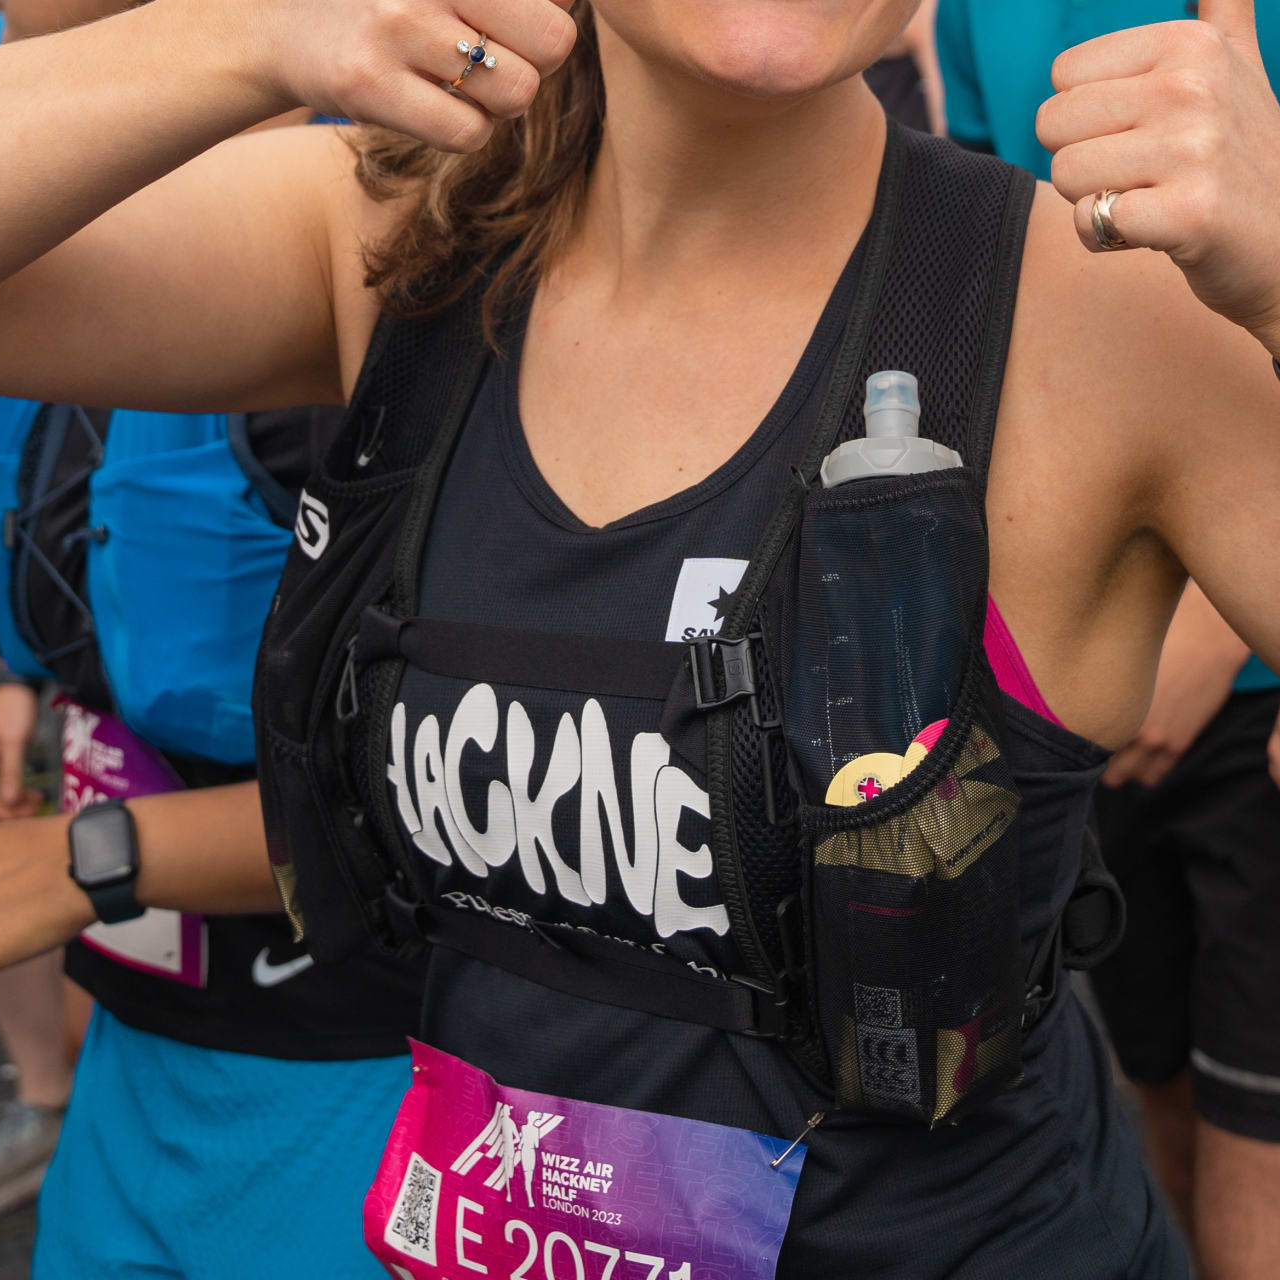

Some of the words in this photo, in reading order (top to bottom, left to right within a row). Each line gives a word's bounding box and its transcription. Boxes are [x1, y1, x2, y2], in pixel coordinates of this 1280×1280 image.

[541, 1151, 580, 1173] WIZZ
[582, 1160, 614, 1179] AIR
[542, 1167, 613, 1194] HACKNEY
[542, 1182, 577, 1202] HALF
[542, 1196, 590, 1219] LONDON
[591, 1209, 623, 1226] 2023
[455, 1195, 489, 1275] E
[504, 1219, 692, 1280] 207
